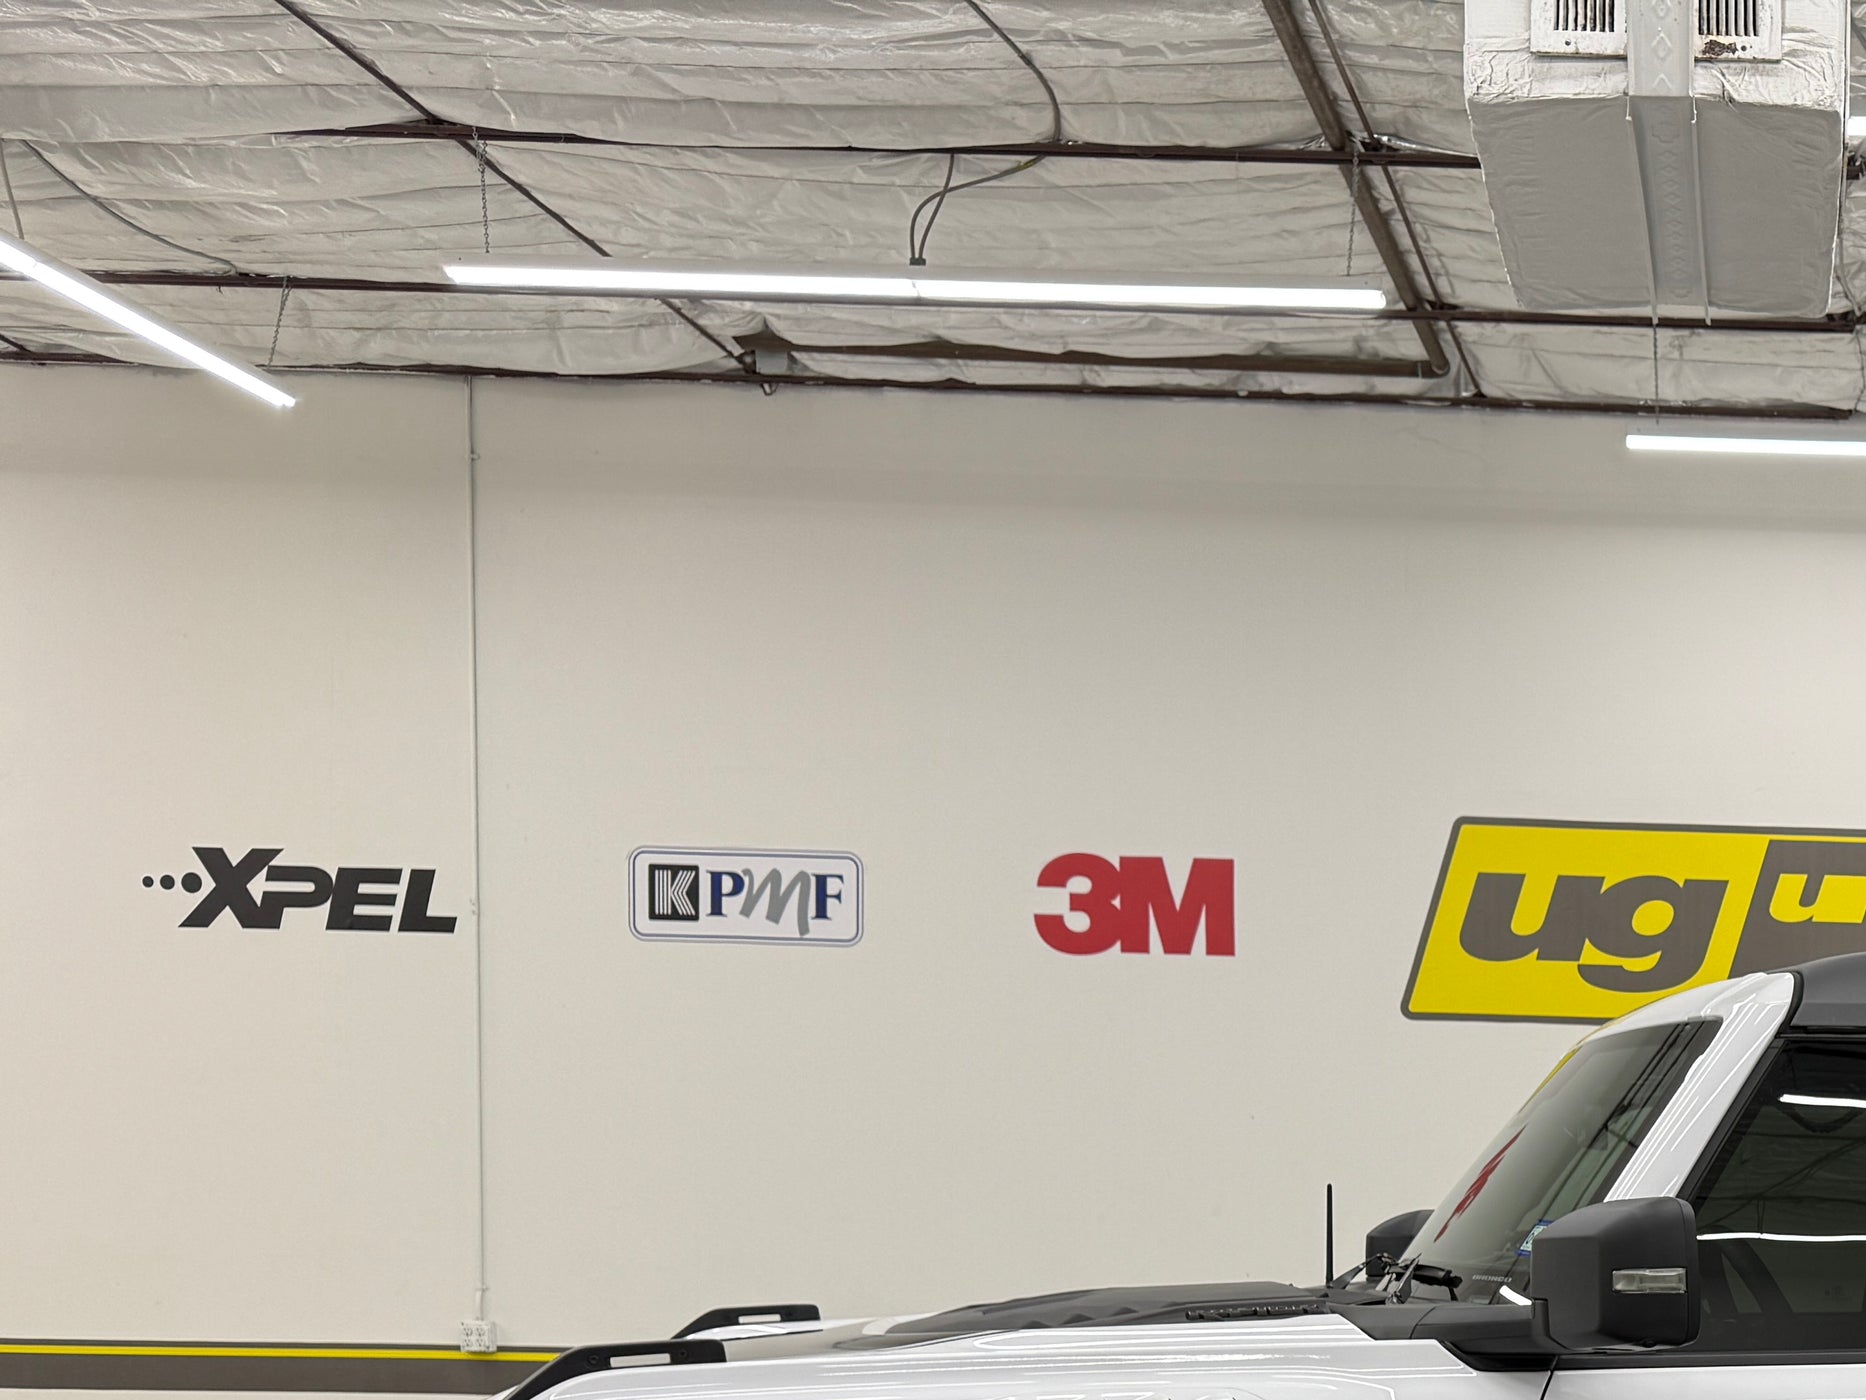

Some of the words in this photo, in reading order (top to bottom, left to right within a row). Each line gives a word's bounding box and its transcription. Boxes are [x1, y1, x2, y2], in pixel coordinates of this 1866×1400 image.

[178, 846, 458, 933] XPEL
[649, 862, 846, 936] KPMF
[1033, 852, 1236, 957] 3M
[1458, 871, 1730, 994] ug
